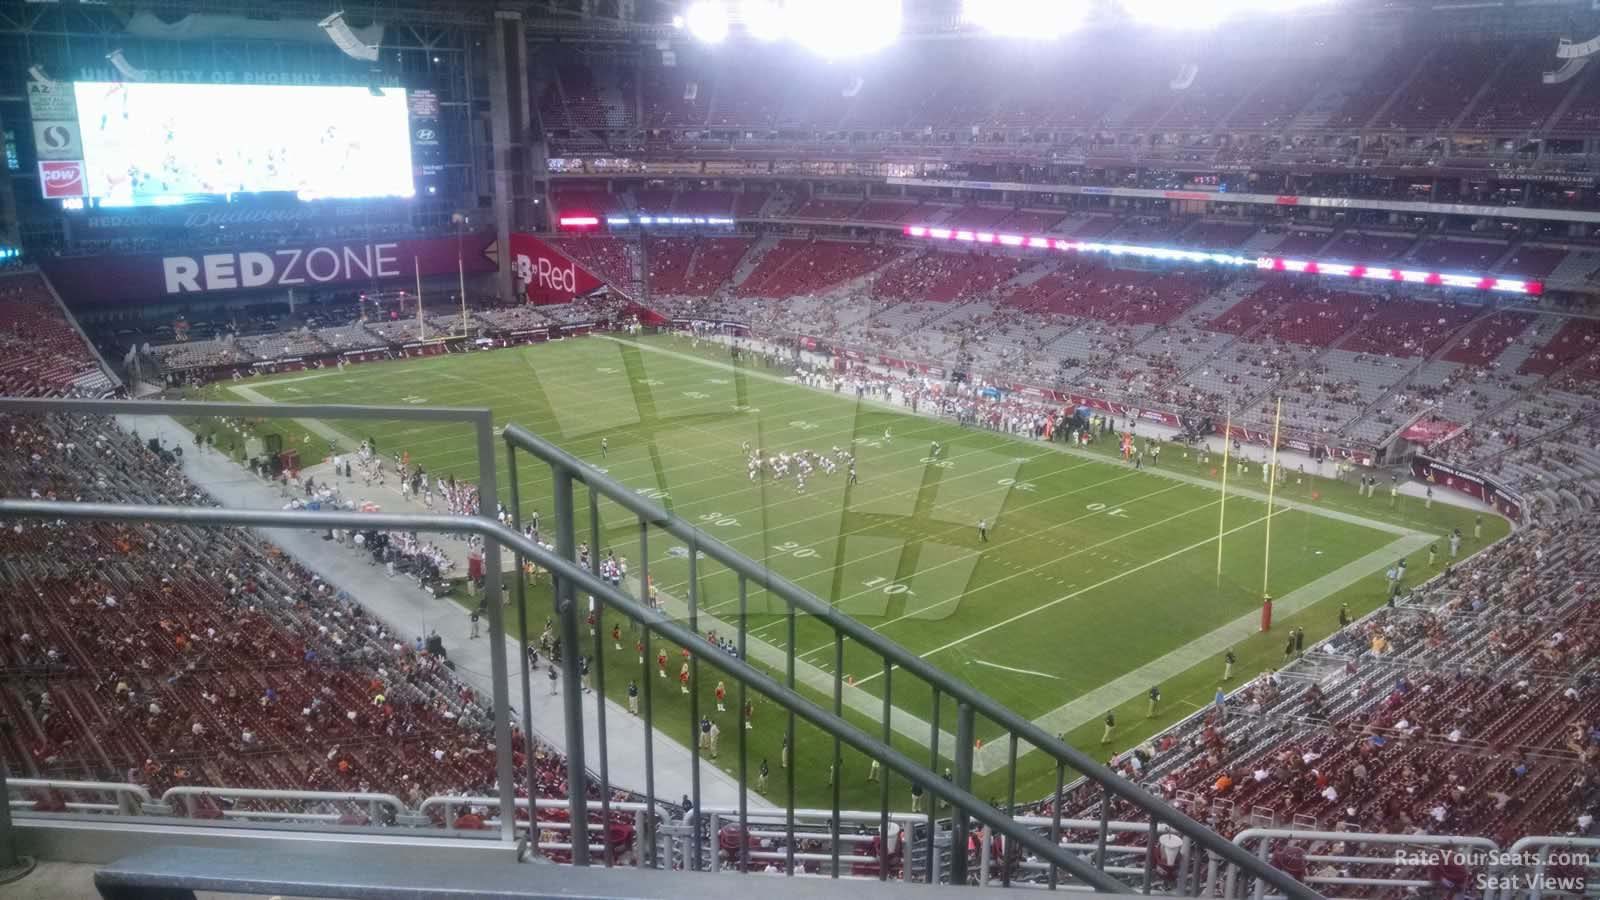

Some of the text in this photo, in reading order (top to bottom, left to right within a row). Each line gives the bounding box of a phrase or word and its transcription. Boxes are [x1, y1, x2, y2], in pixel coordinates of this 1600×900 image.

[80, 67, 203, 83] UNIRSITY
[162, 243, 400, 294] REDZONE
[538, 257, 577, 294] Red
[771, 540, 818, 559] 20
[861, 576, 909, 595] 10
